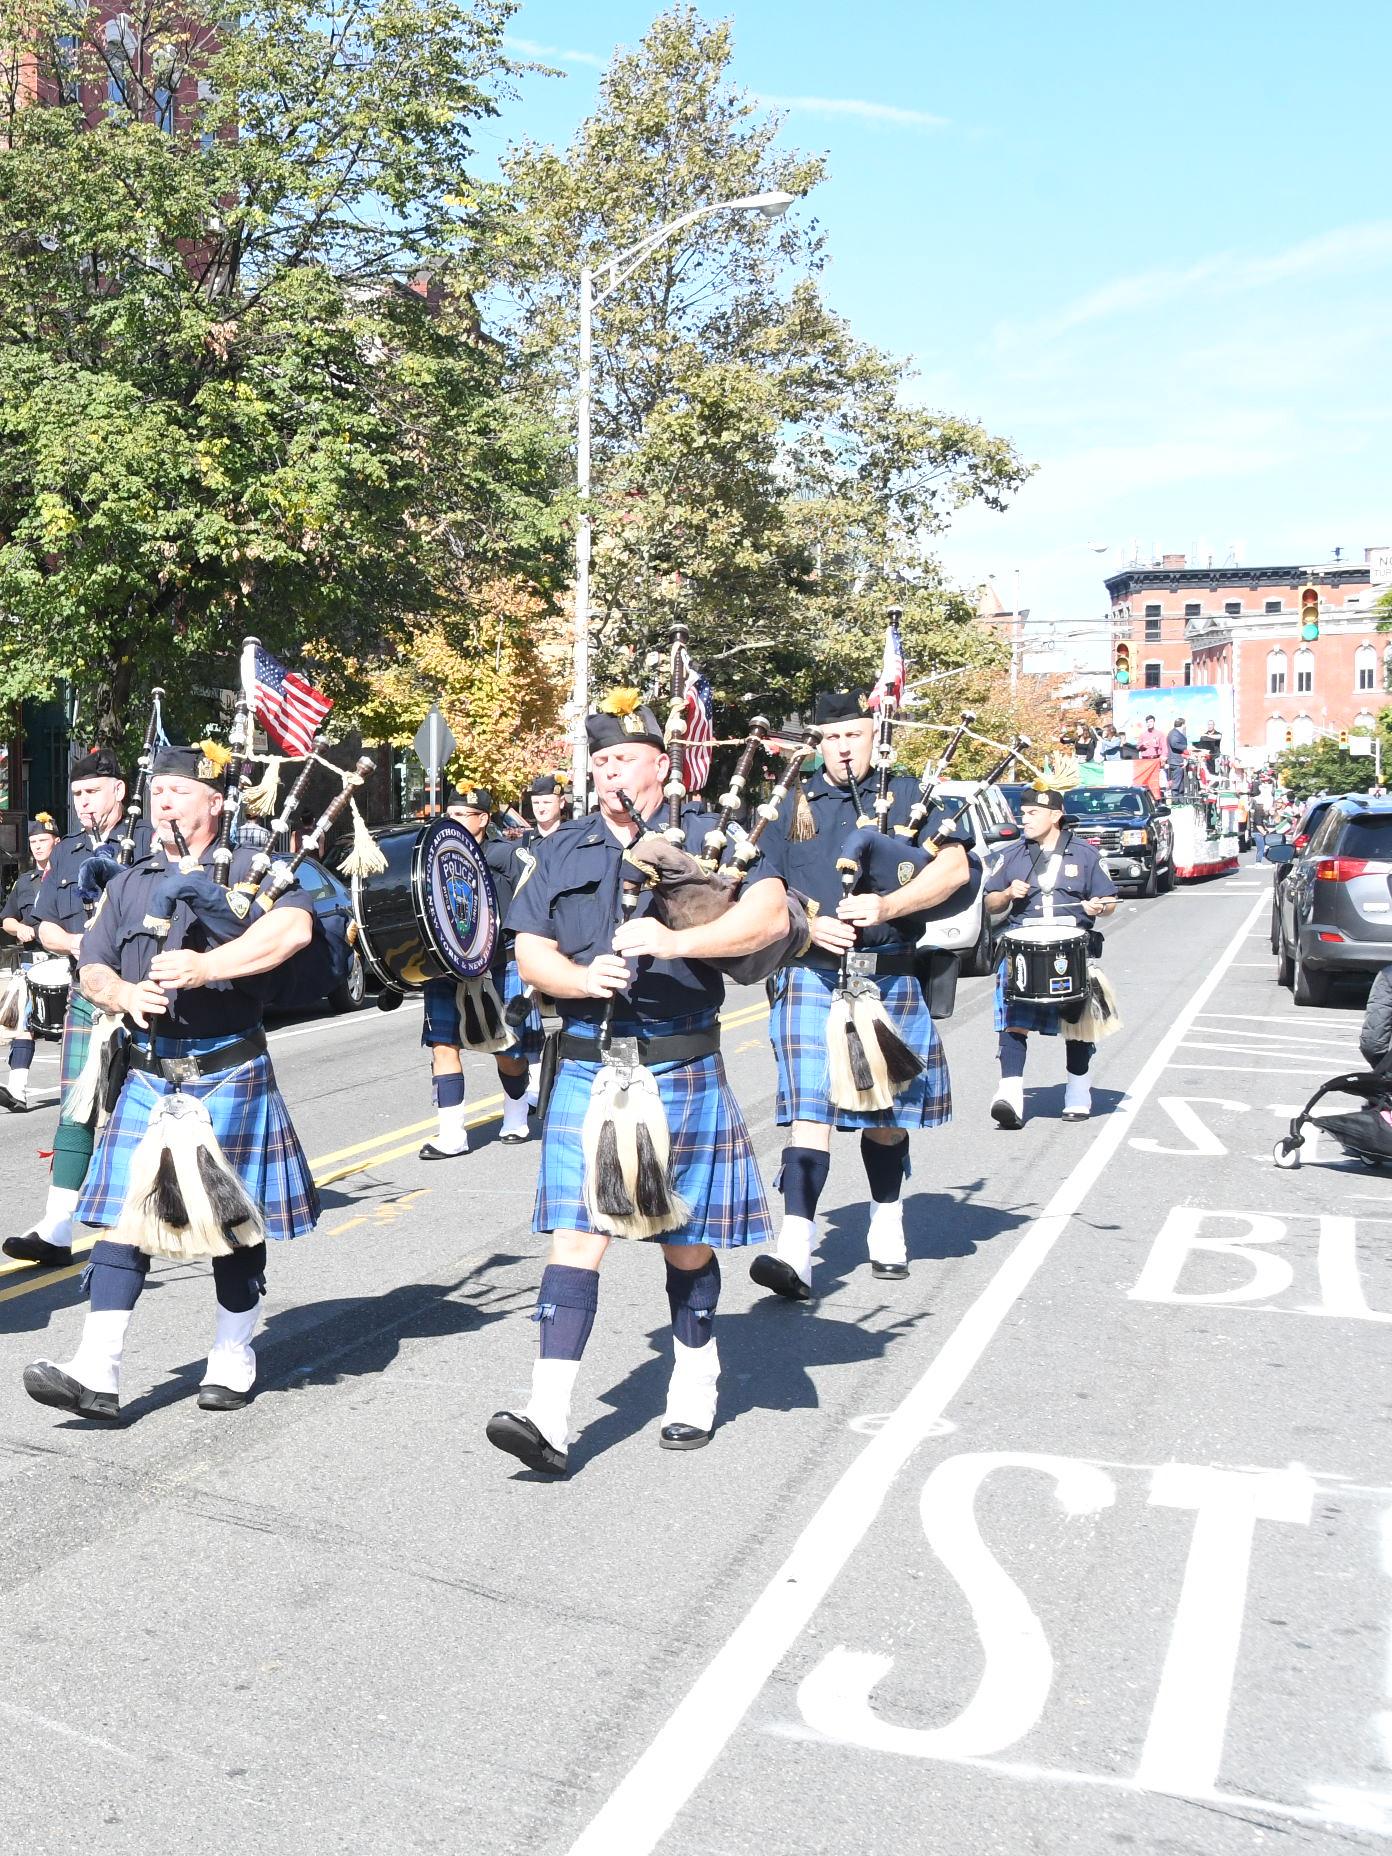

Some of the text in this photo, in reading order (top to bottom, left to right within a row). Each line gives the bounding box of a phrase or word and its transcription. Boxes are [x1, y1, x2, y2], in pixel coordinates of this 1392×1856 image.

[426, 828, 494, 906] PORT AUTHORITY POLICE
[442, 861, 474, 884] POLICE
[439, 933, 460, 966] YORK
[468, 957, 484, 971] NEW
